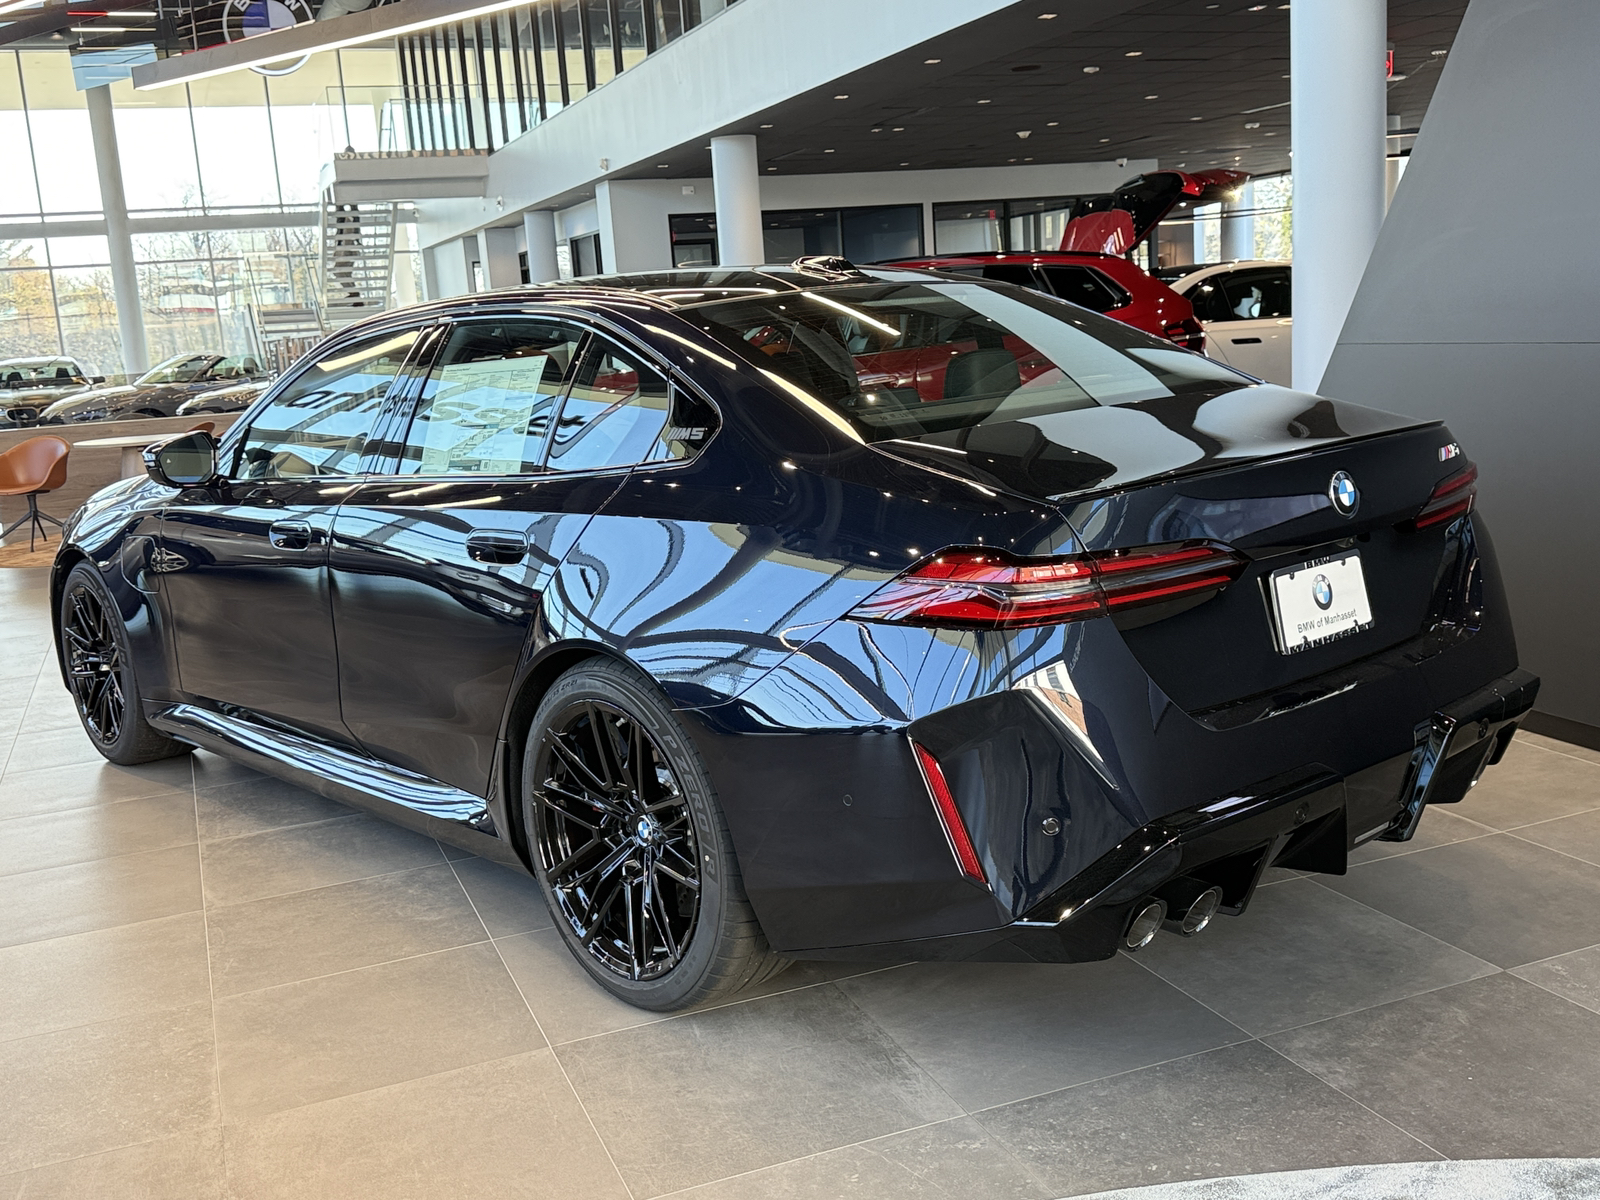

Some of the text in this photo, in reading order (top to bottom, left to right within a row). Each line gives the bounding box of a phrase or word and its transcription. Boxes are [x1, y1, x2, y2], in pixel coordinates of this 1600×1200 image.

[234, 0, 301, 12] BW
[1304, 556, 1330, 569] BMW
[1297, 608, 1358, 634] BMW of Manhasset
[1288, 622, 1371, 655] MANHASSET
[662, 734, 678, 749] P
[674, 755, 709, 832] ZERO
